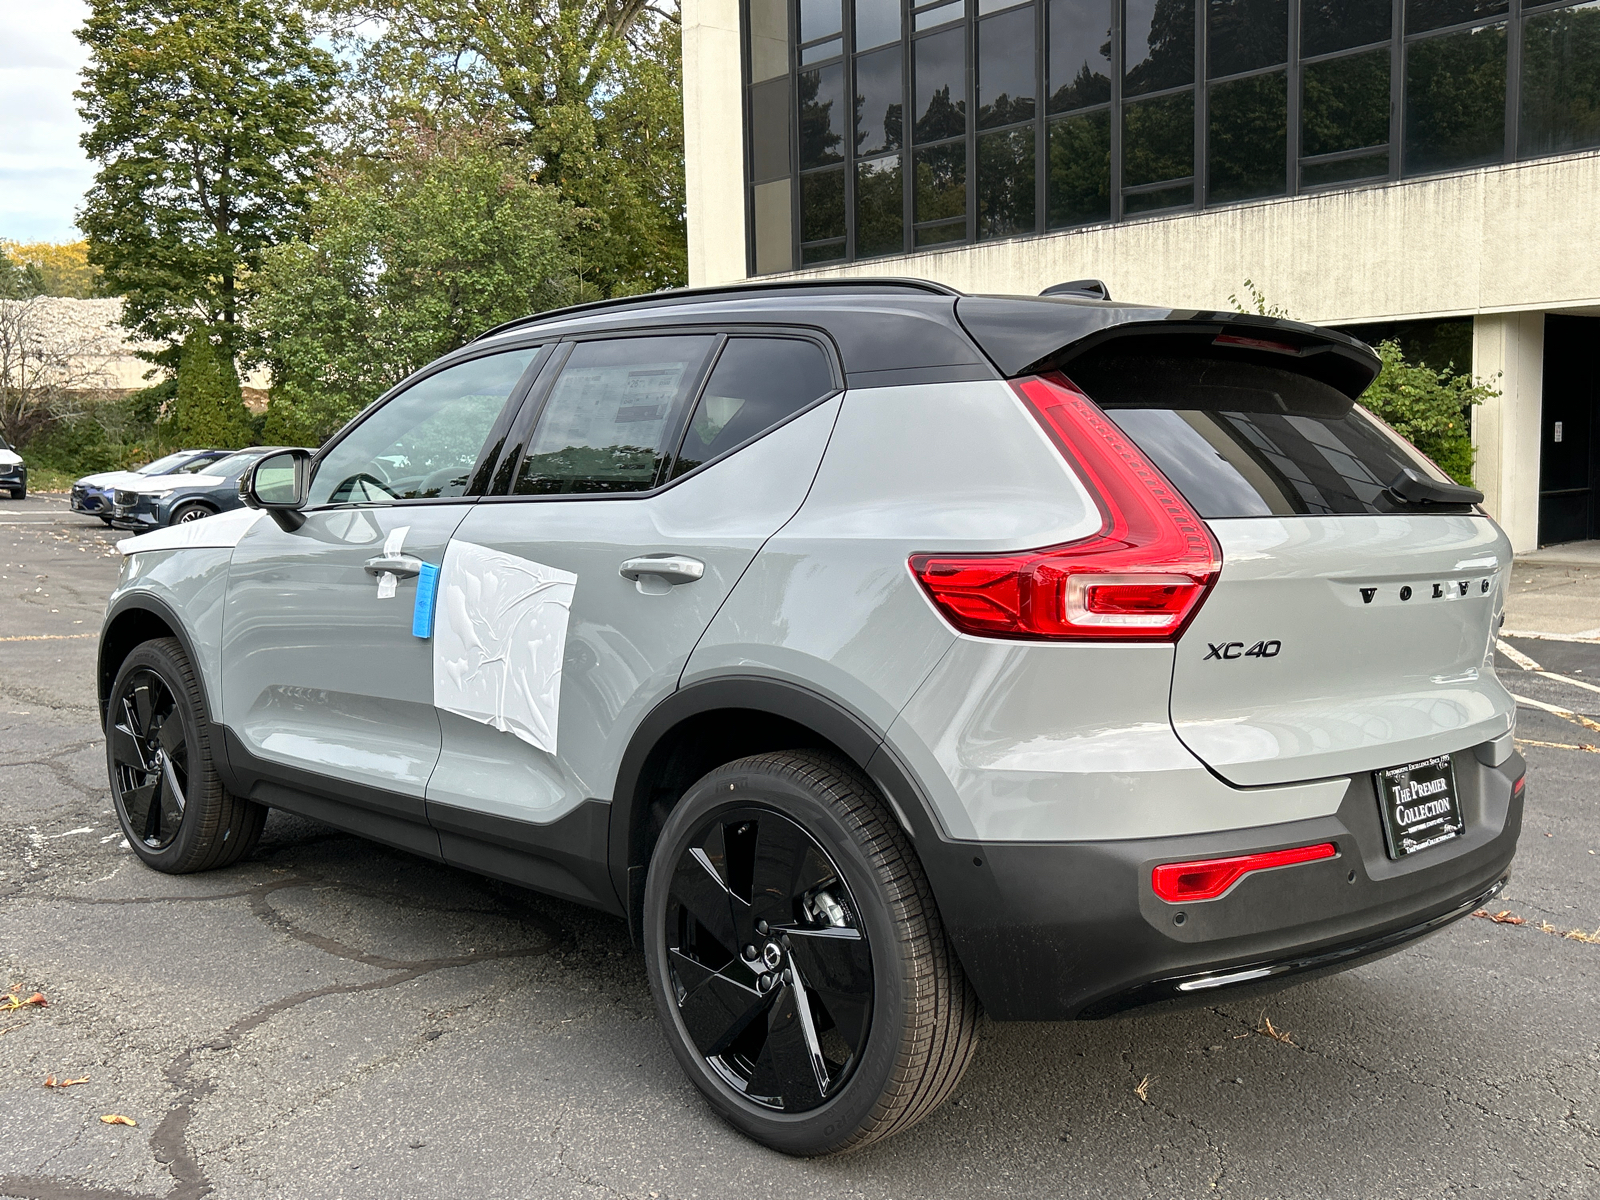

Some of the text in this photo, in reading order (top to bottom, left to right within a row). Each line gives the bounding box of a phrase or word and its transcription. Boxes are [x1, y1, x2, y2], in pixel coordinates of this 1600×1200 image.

[1359, 579, 1490, 604] VOLVO
[1202, 640, 1282, 661] XC40
[1392, 777, 1448, 805] THE PREMIER
[1395, 797, 1451, 826] COLLECTION
